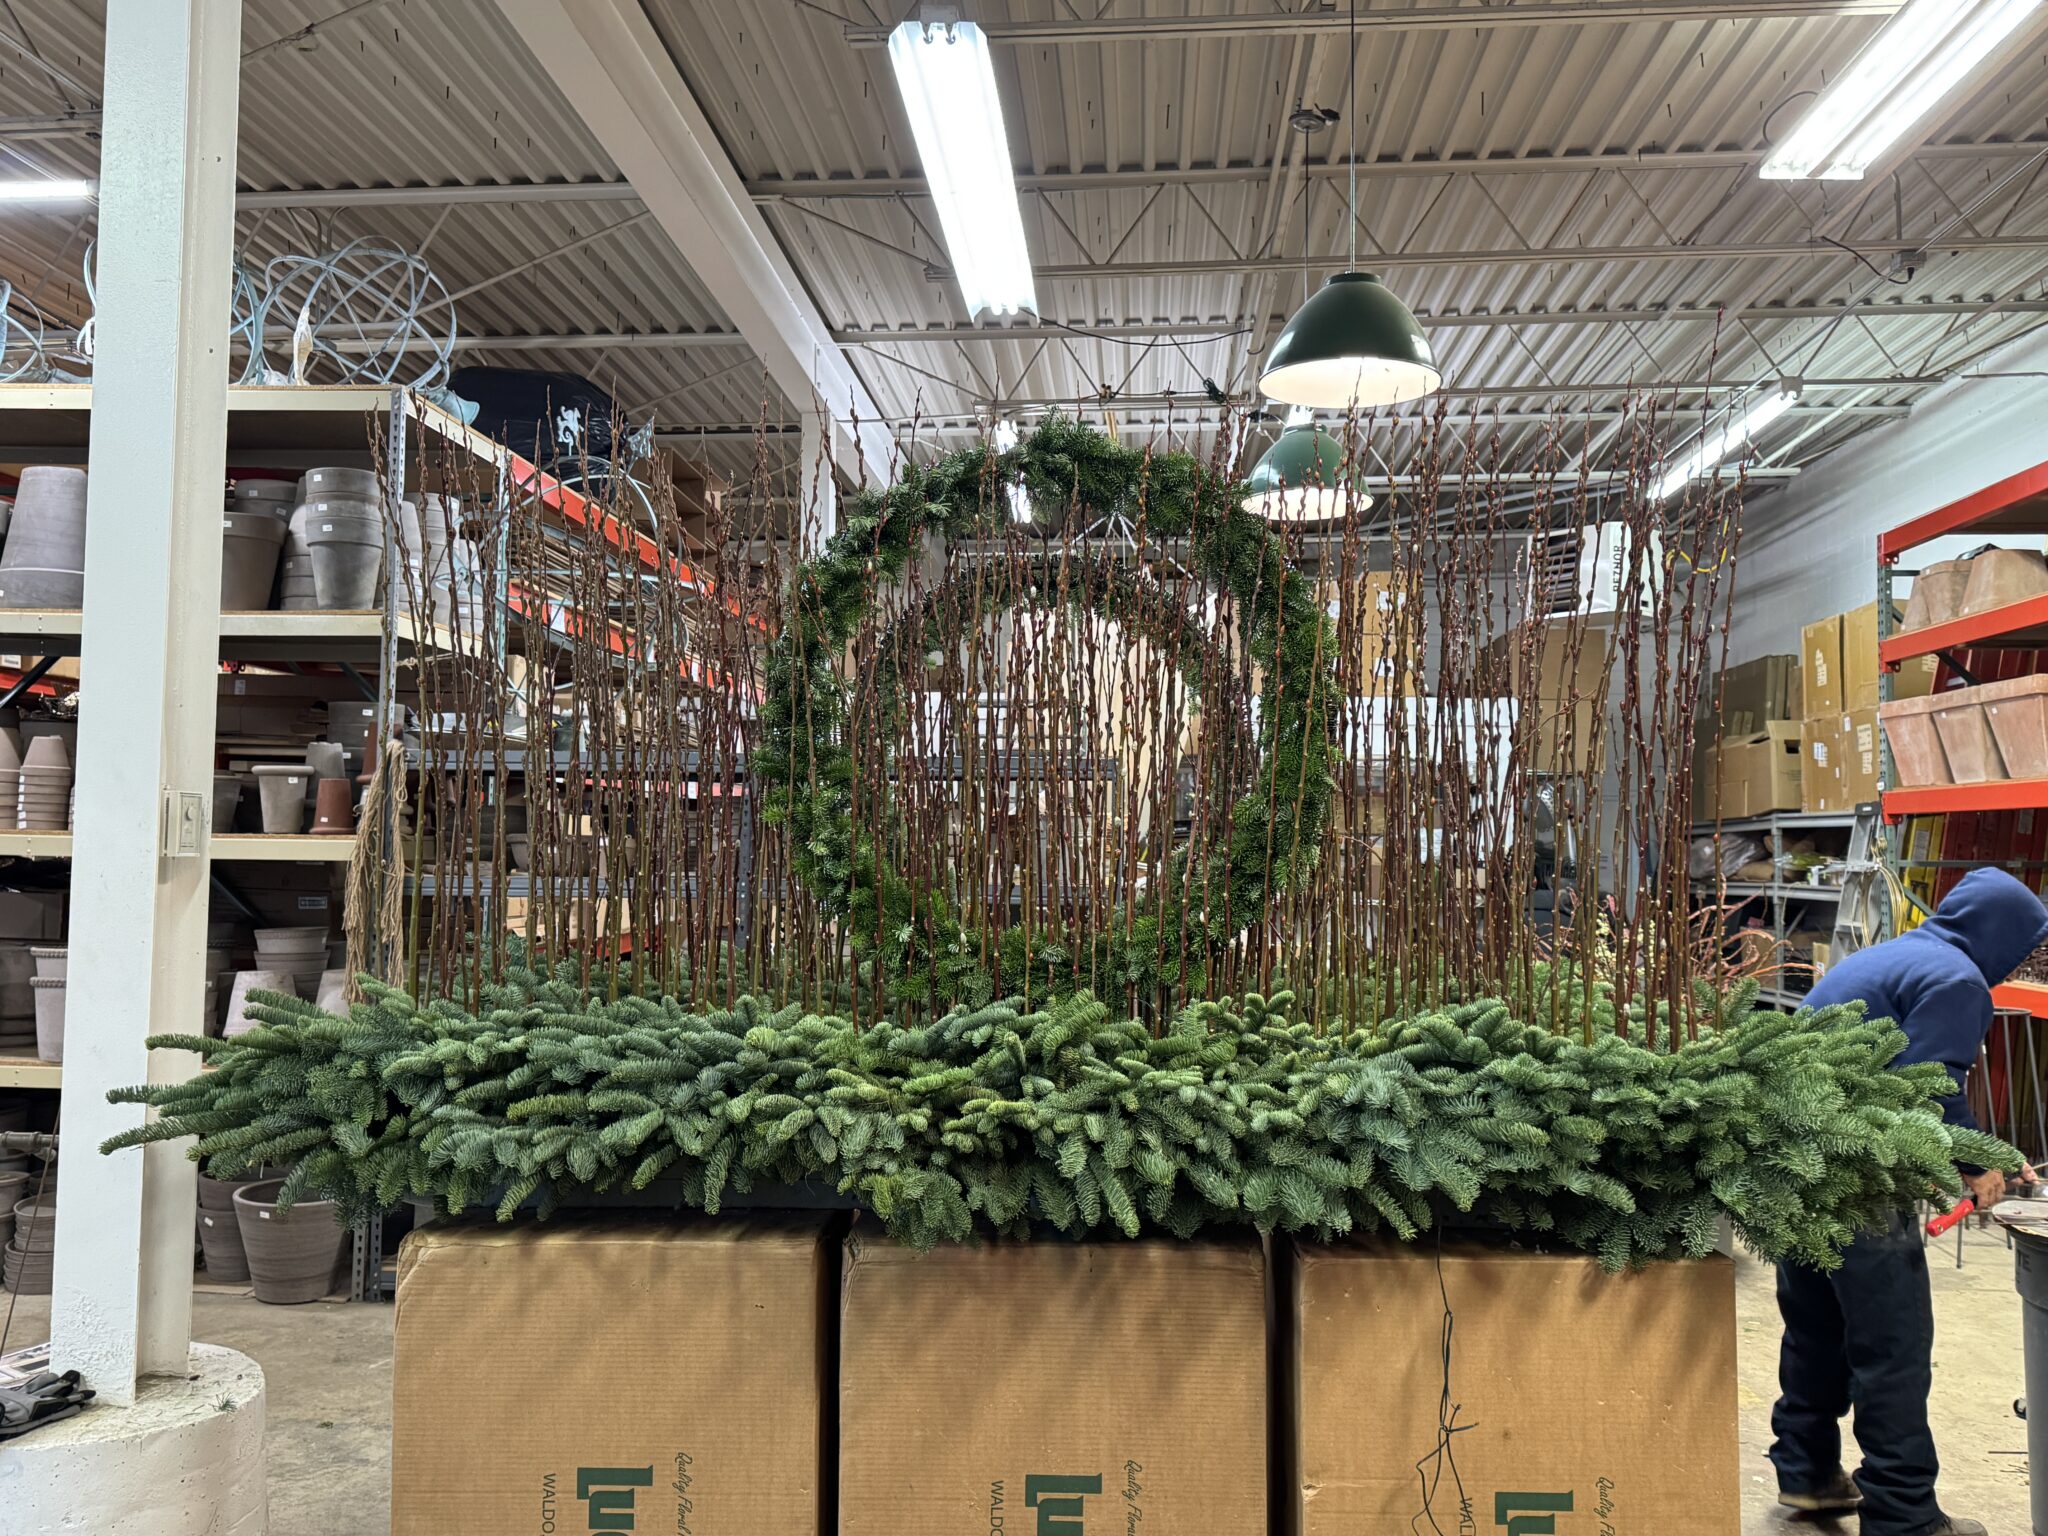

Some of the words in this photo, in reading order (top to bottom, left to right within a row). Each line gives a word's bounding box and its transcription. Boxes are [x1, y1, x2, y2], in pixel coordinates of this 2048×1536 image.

[671, 1452, 693, 1494] Quality
[1122, 1459, 1143, 1504] Quality
[677, 1495, 693, 1535] Floral
[1459, 1497, 1473, 1536] WAL
[1593, 1476, 1616, 1519] Quality
